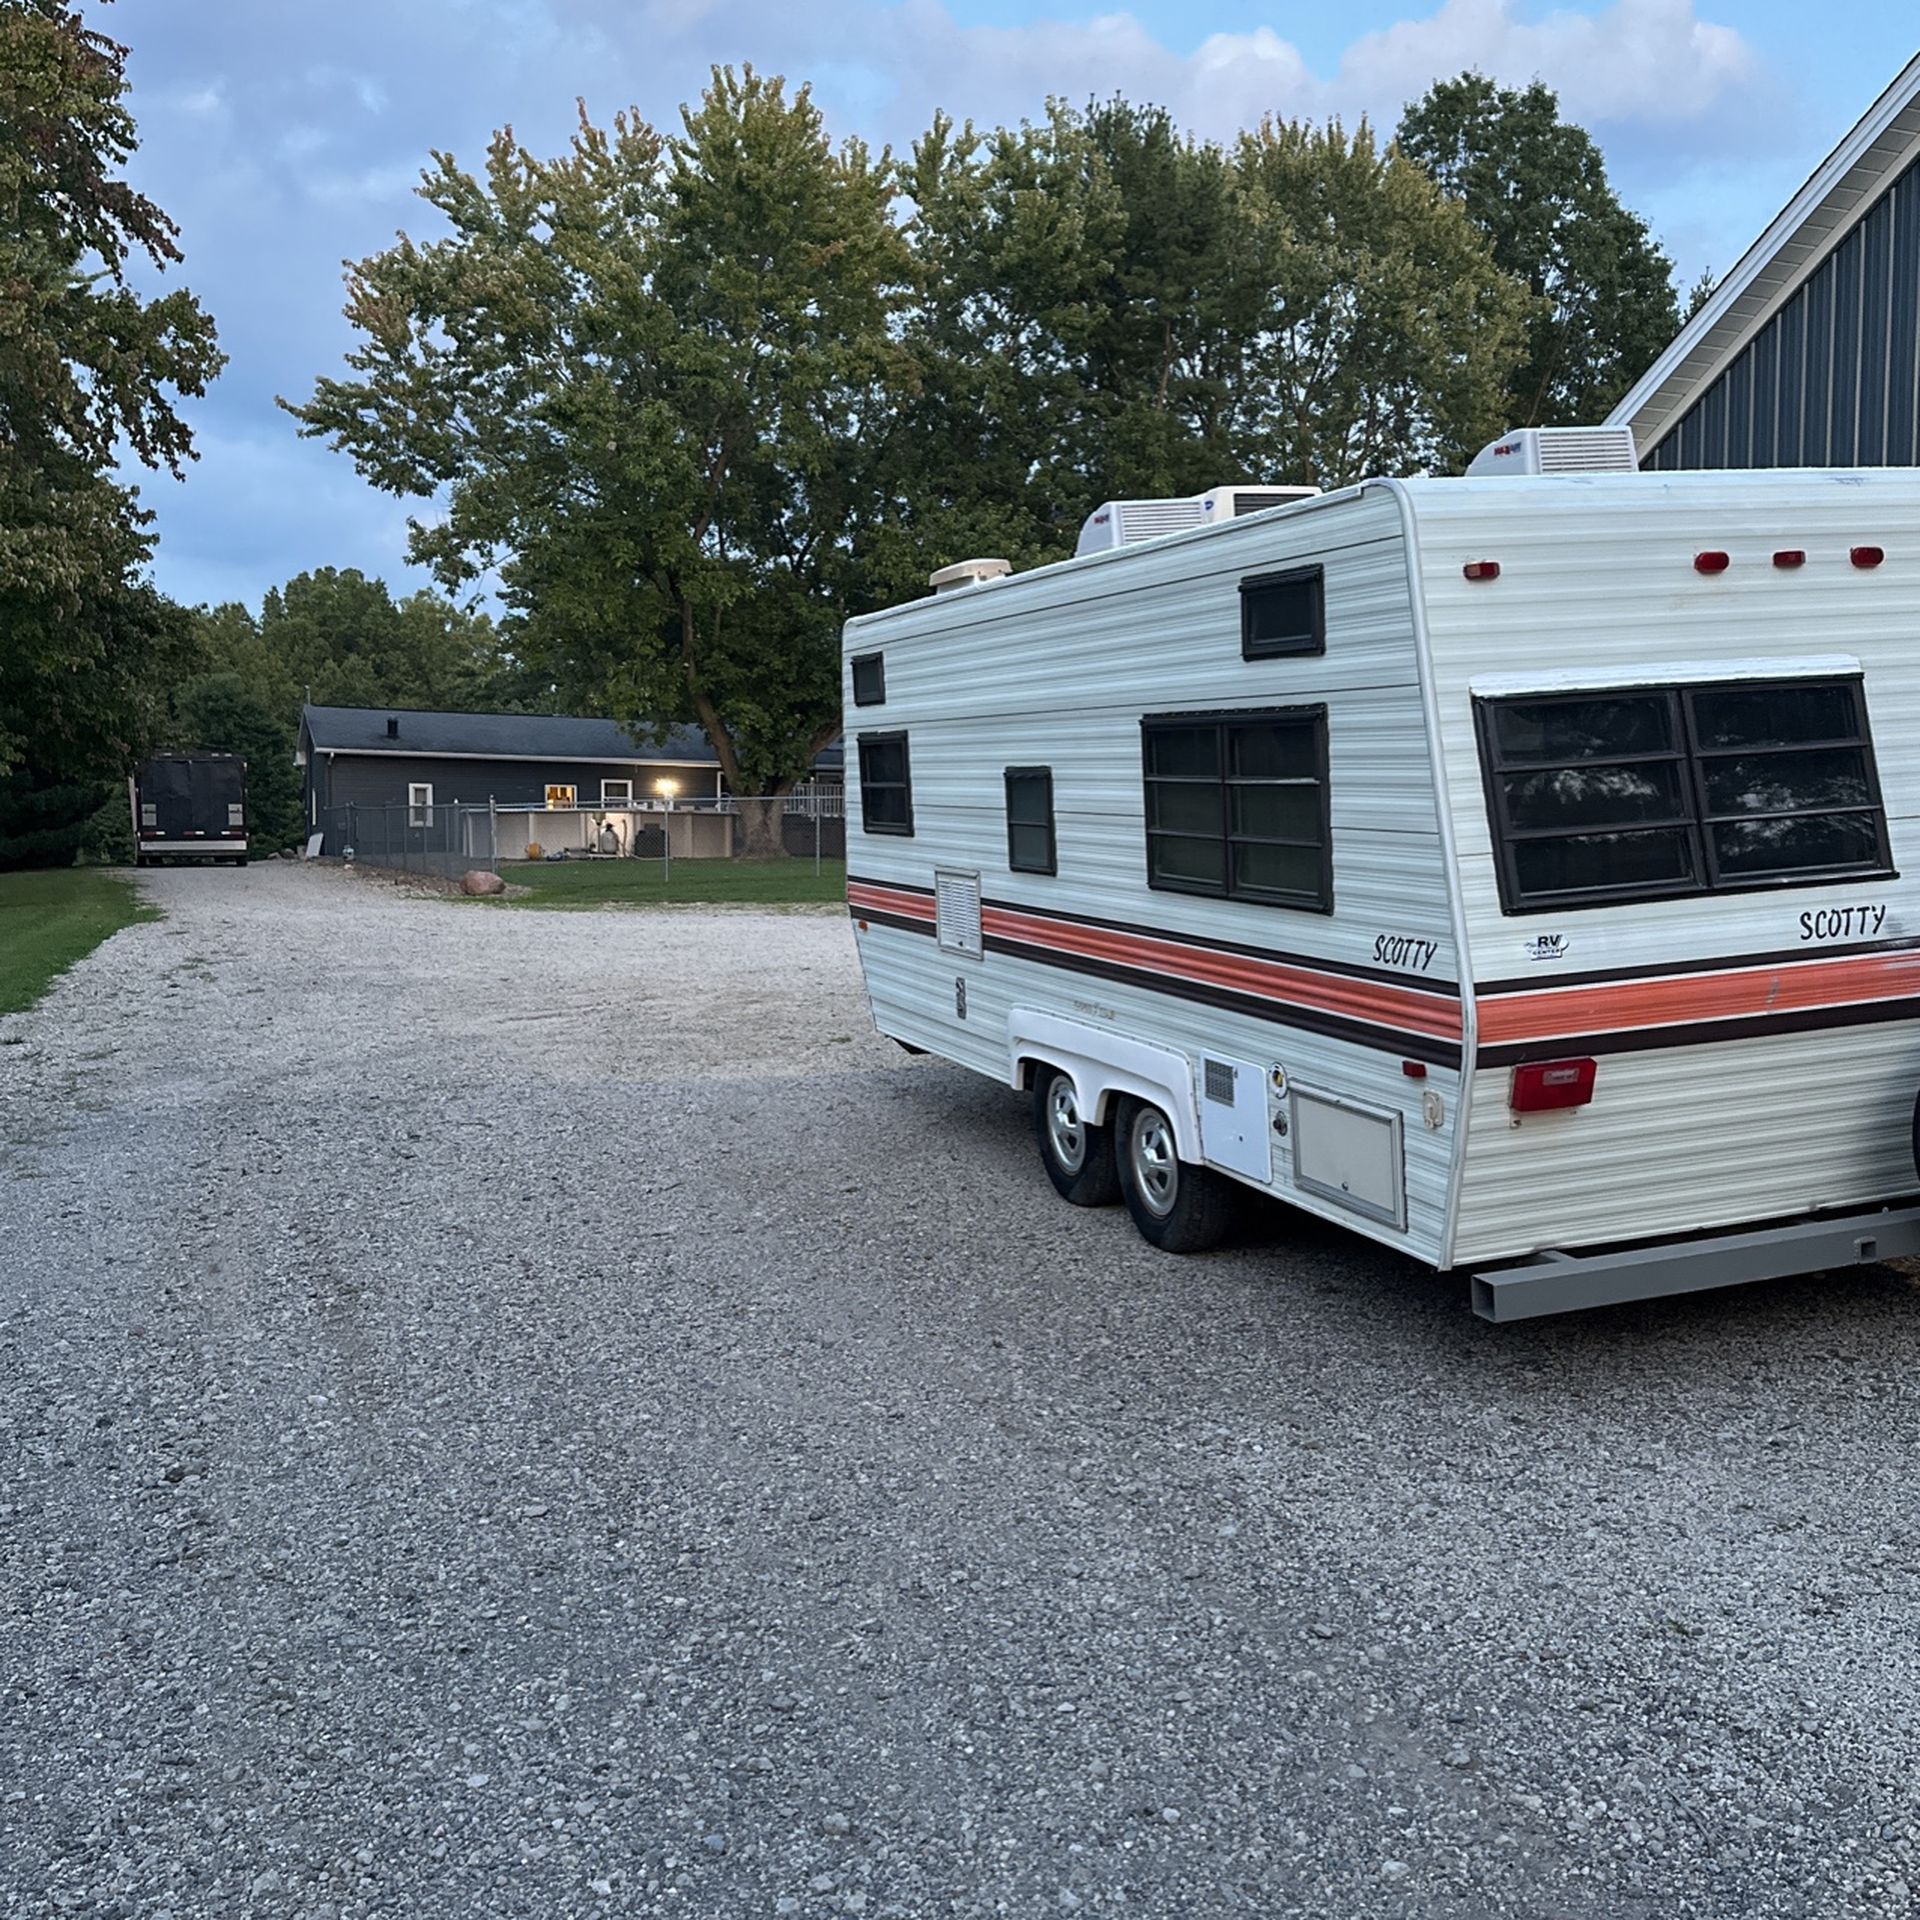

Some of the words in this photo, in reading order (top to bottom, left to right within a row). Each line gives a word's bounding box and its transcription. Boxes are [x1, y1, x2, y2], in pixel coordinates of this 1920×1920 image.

[1800, 904, 1886, 940] SCOTTY
[1373, 934, 1438, 971] SCOTTY
[1537, 934, 1562, 947] RV
